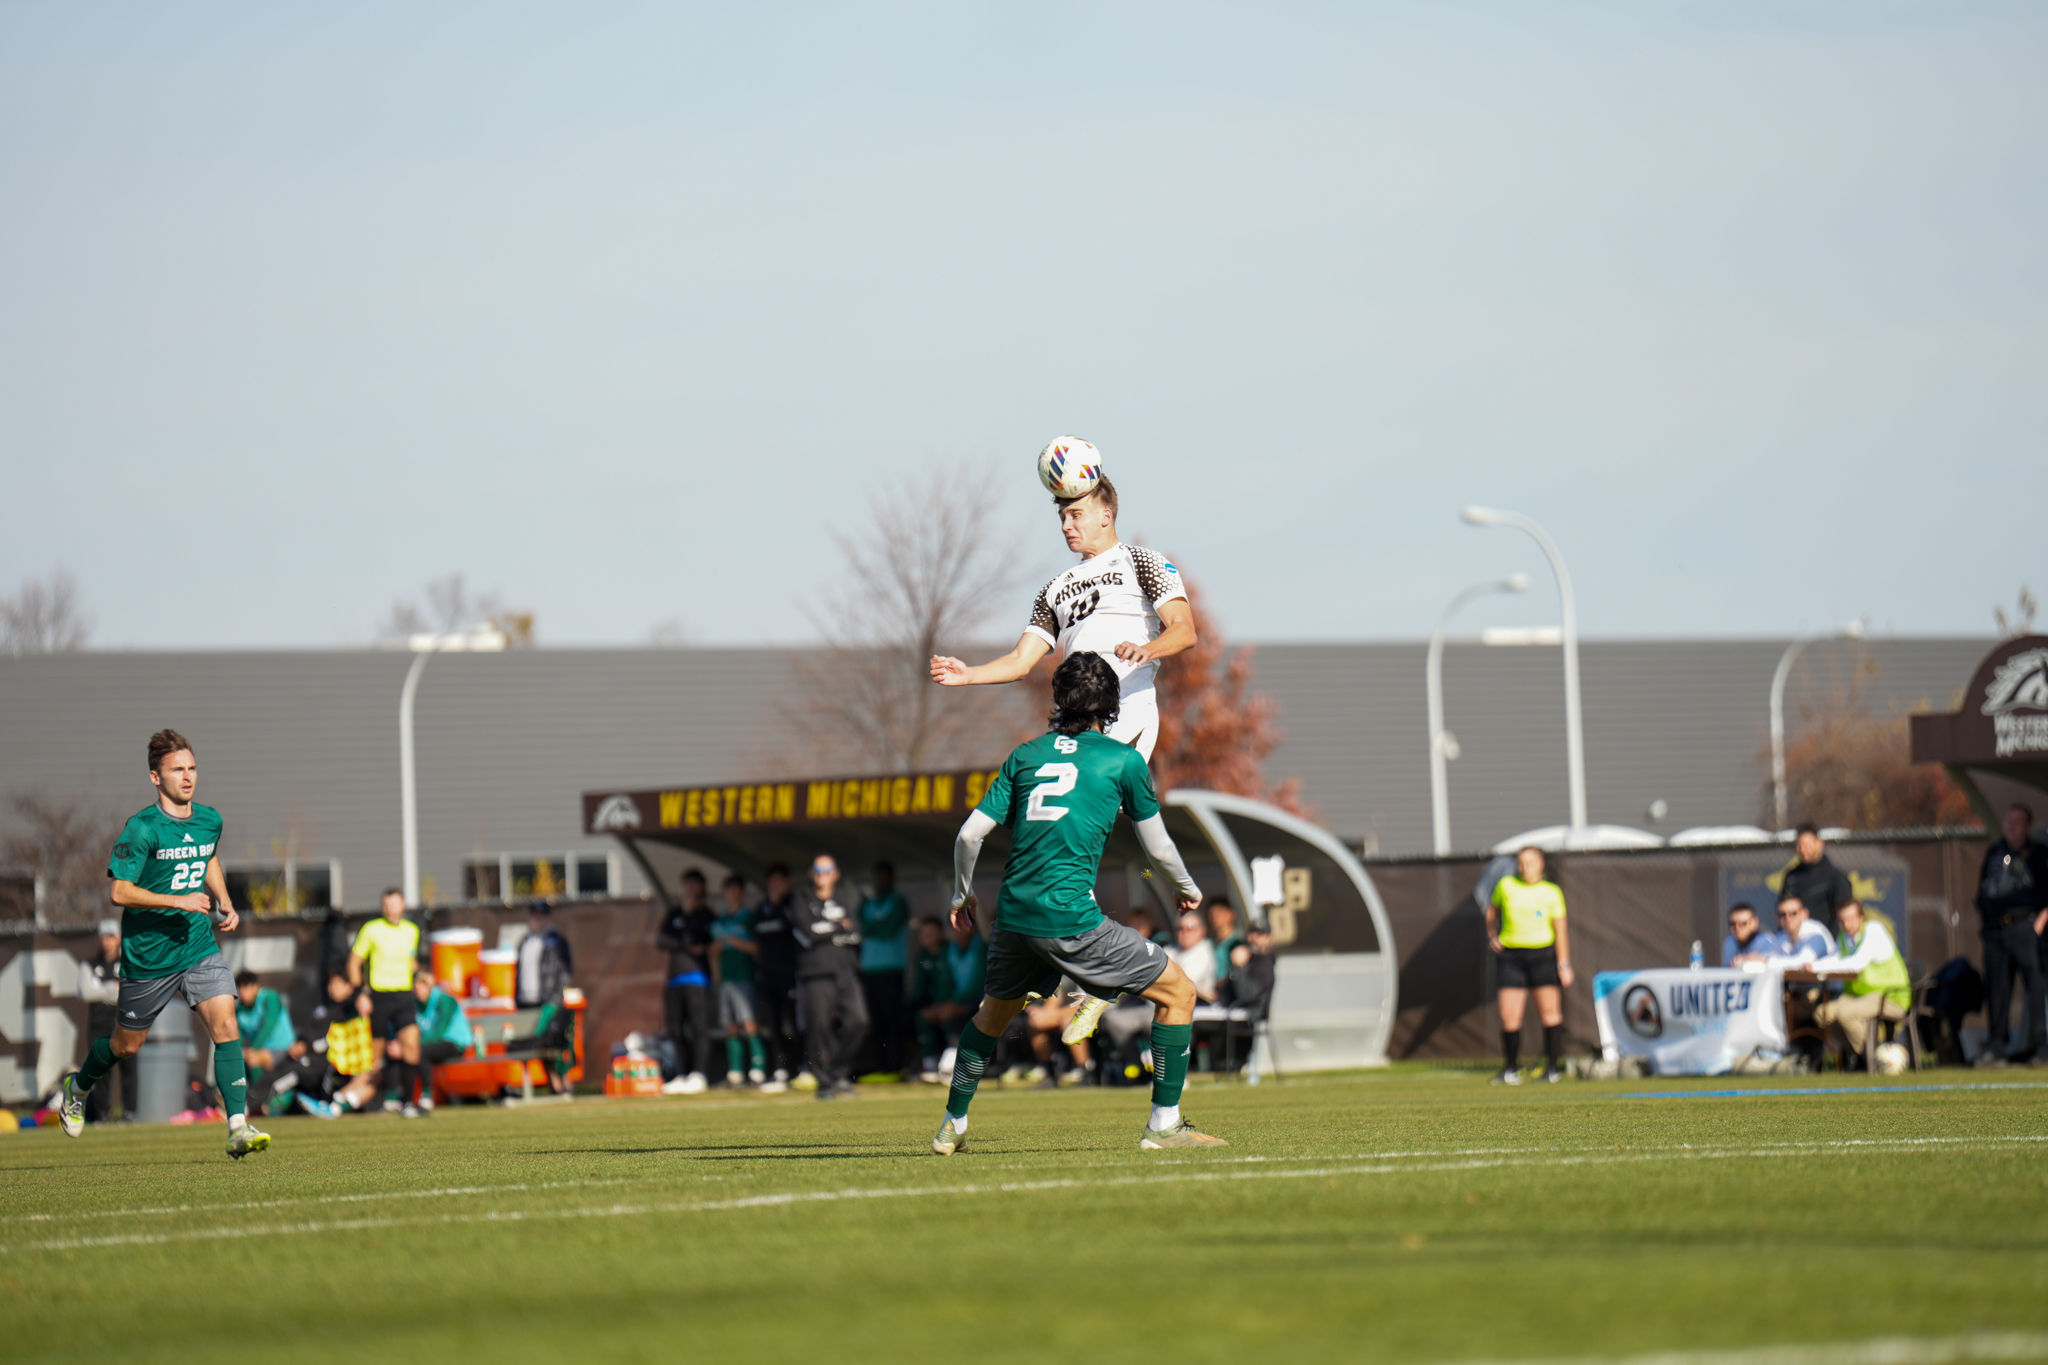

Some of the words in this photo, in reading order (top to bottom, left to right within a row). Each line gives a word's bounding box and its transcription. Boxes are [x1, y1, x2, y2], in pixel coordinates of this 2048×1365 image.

[1055, 572, 1123, 606] BRONCOS
[1066, 588, 1100, 628] 10
[659, 783, 795, 829] WESTERN
[805, 773, 954, 819] MICHIGAN
[1026, 762, 1079, 821] 2
[156, 846, 198, 860] GREEN
[170, 861, 206, 890] 22
[1669, 982, 1751, 1017] UNITED
